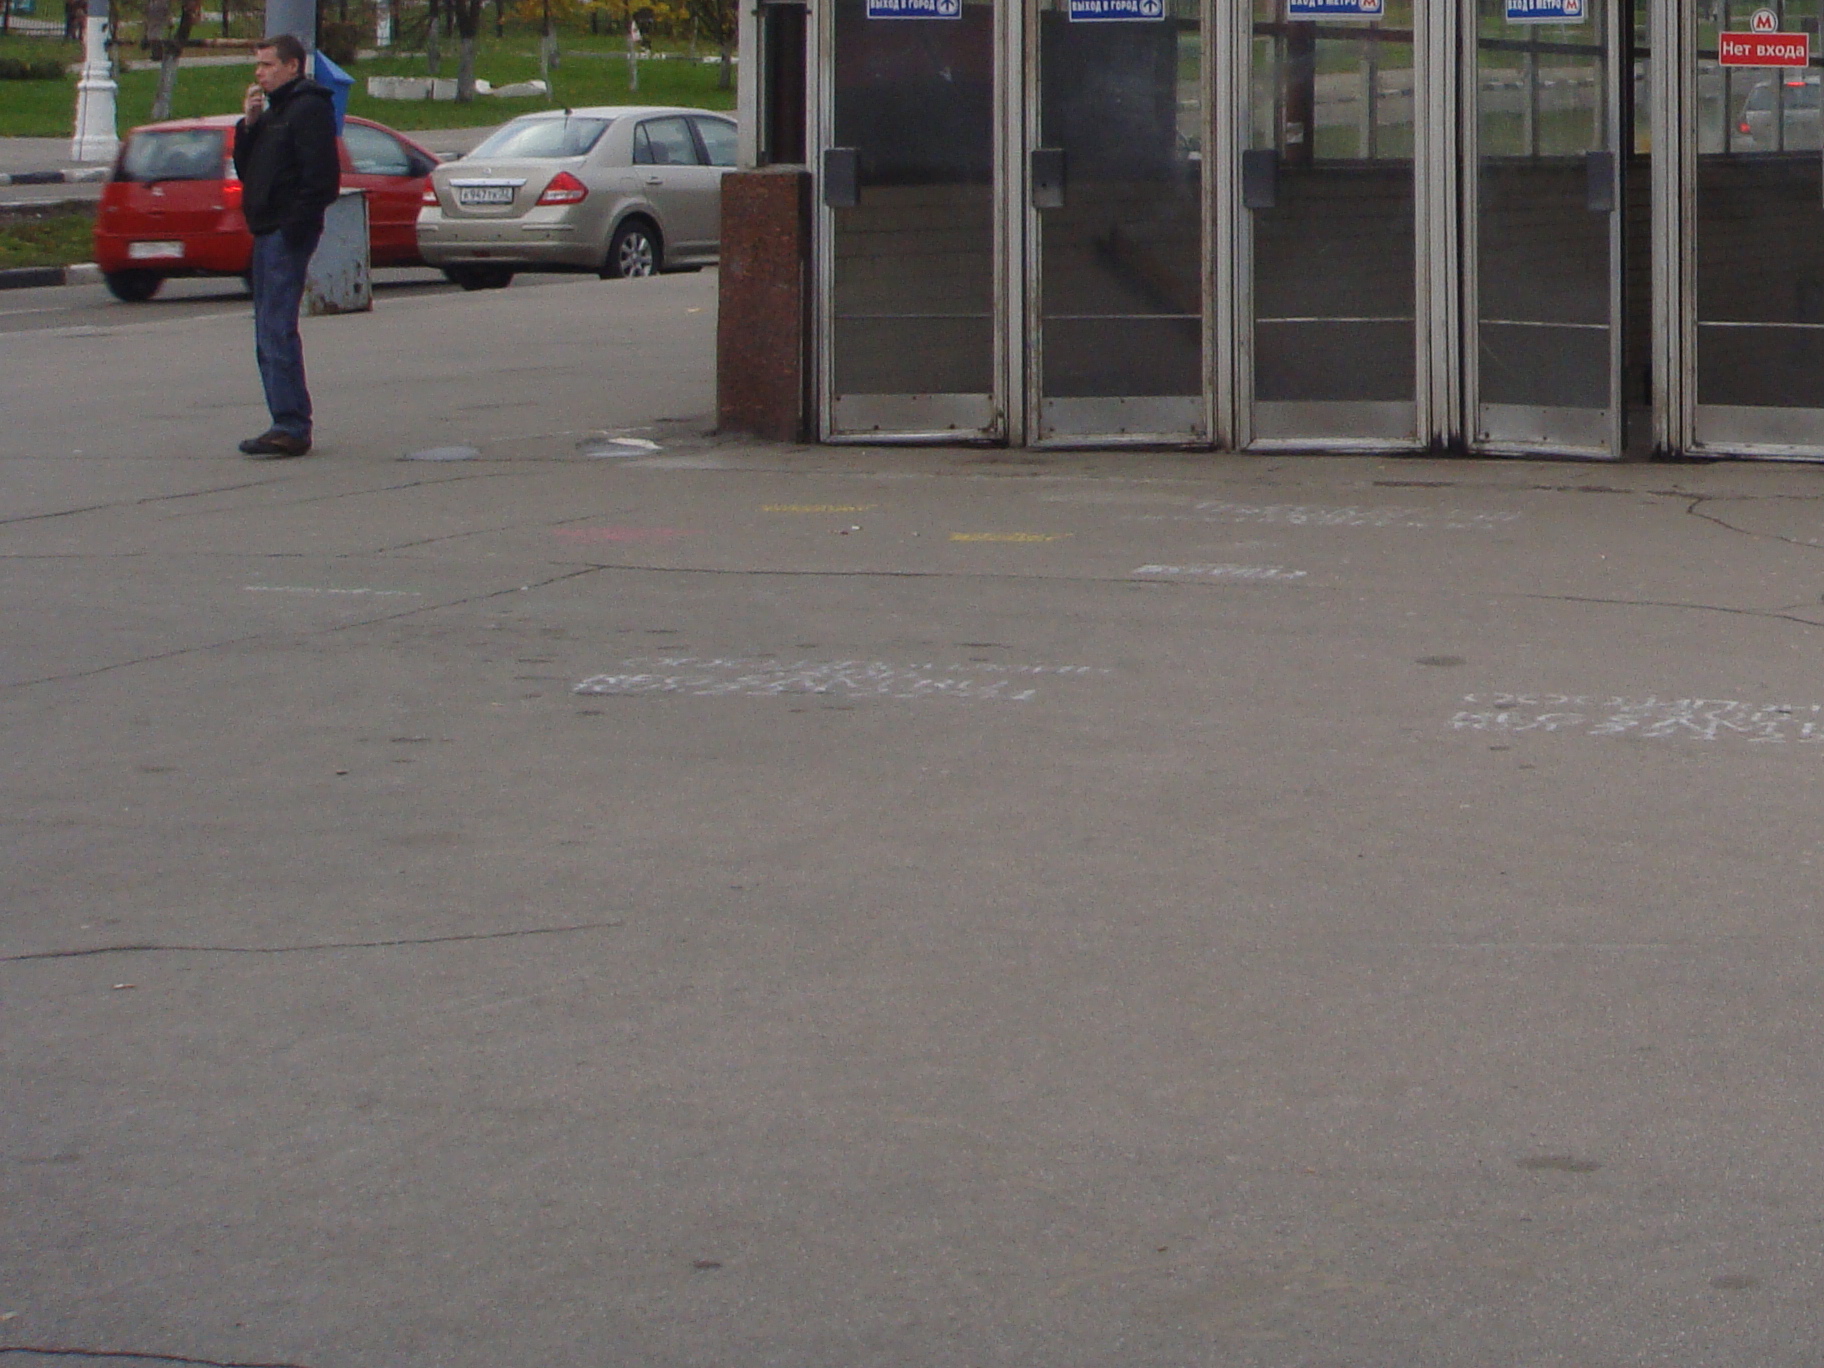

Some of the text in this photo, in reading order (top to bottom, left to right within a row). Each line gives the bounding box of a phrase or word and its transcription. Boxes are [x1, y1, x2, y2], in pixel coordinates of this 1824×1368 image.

[1072, 0, 1138, 12] ВЫХОД В ГОРОД
[1507, 0, 1528, 12] ВХОД
[1755, 14, 1773, 29] М
[1722, 41, 1805, 60] Нет входа
